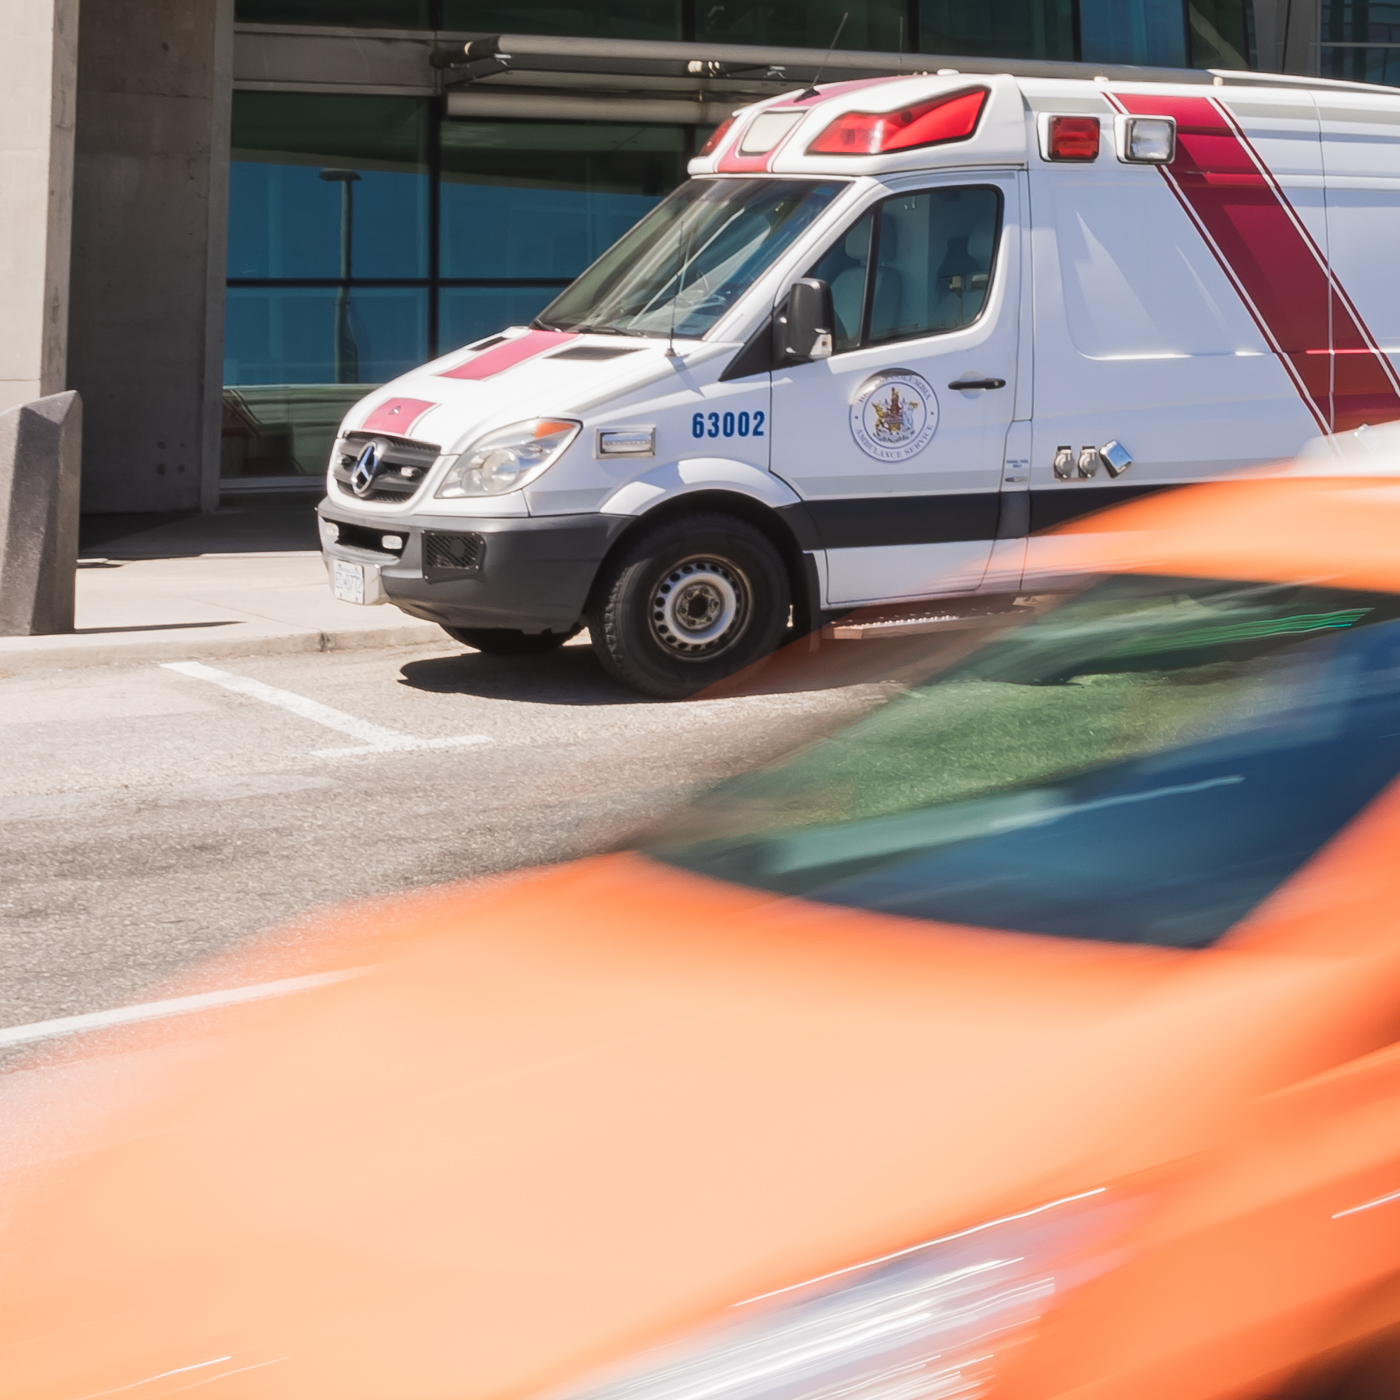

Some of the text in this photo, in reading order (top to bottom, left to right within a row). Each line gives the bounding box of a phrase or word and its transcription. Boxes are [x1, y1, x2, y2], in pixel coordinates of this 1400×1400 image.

[692, 410, 765, 438] 63002
[856, 423, 934, 459] AMBULANCE SERVICE
